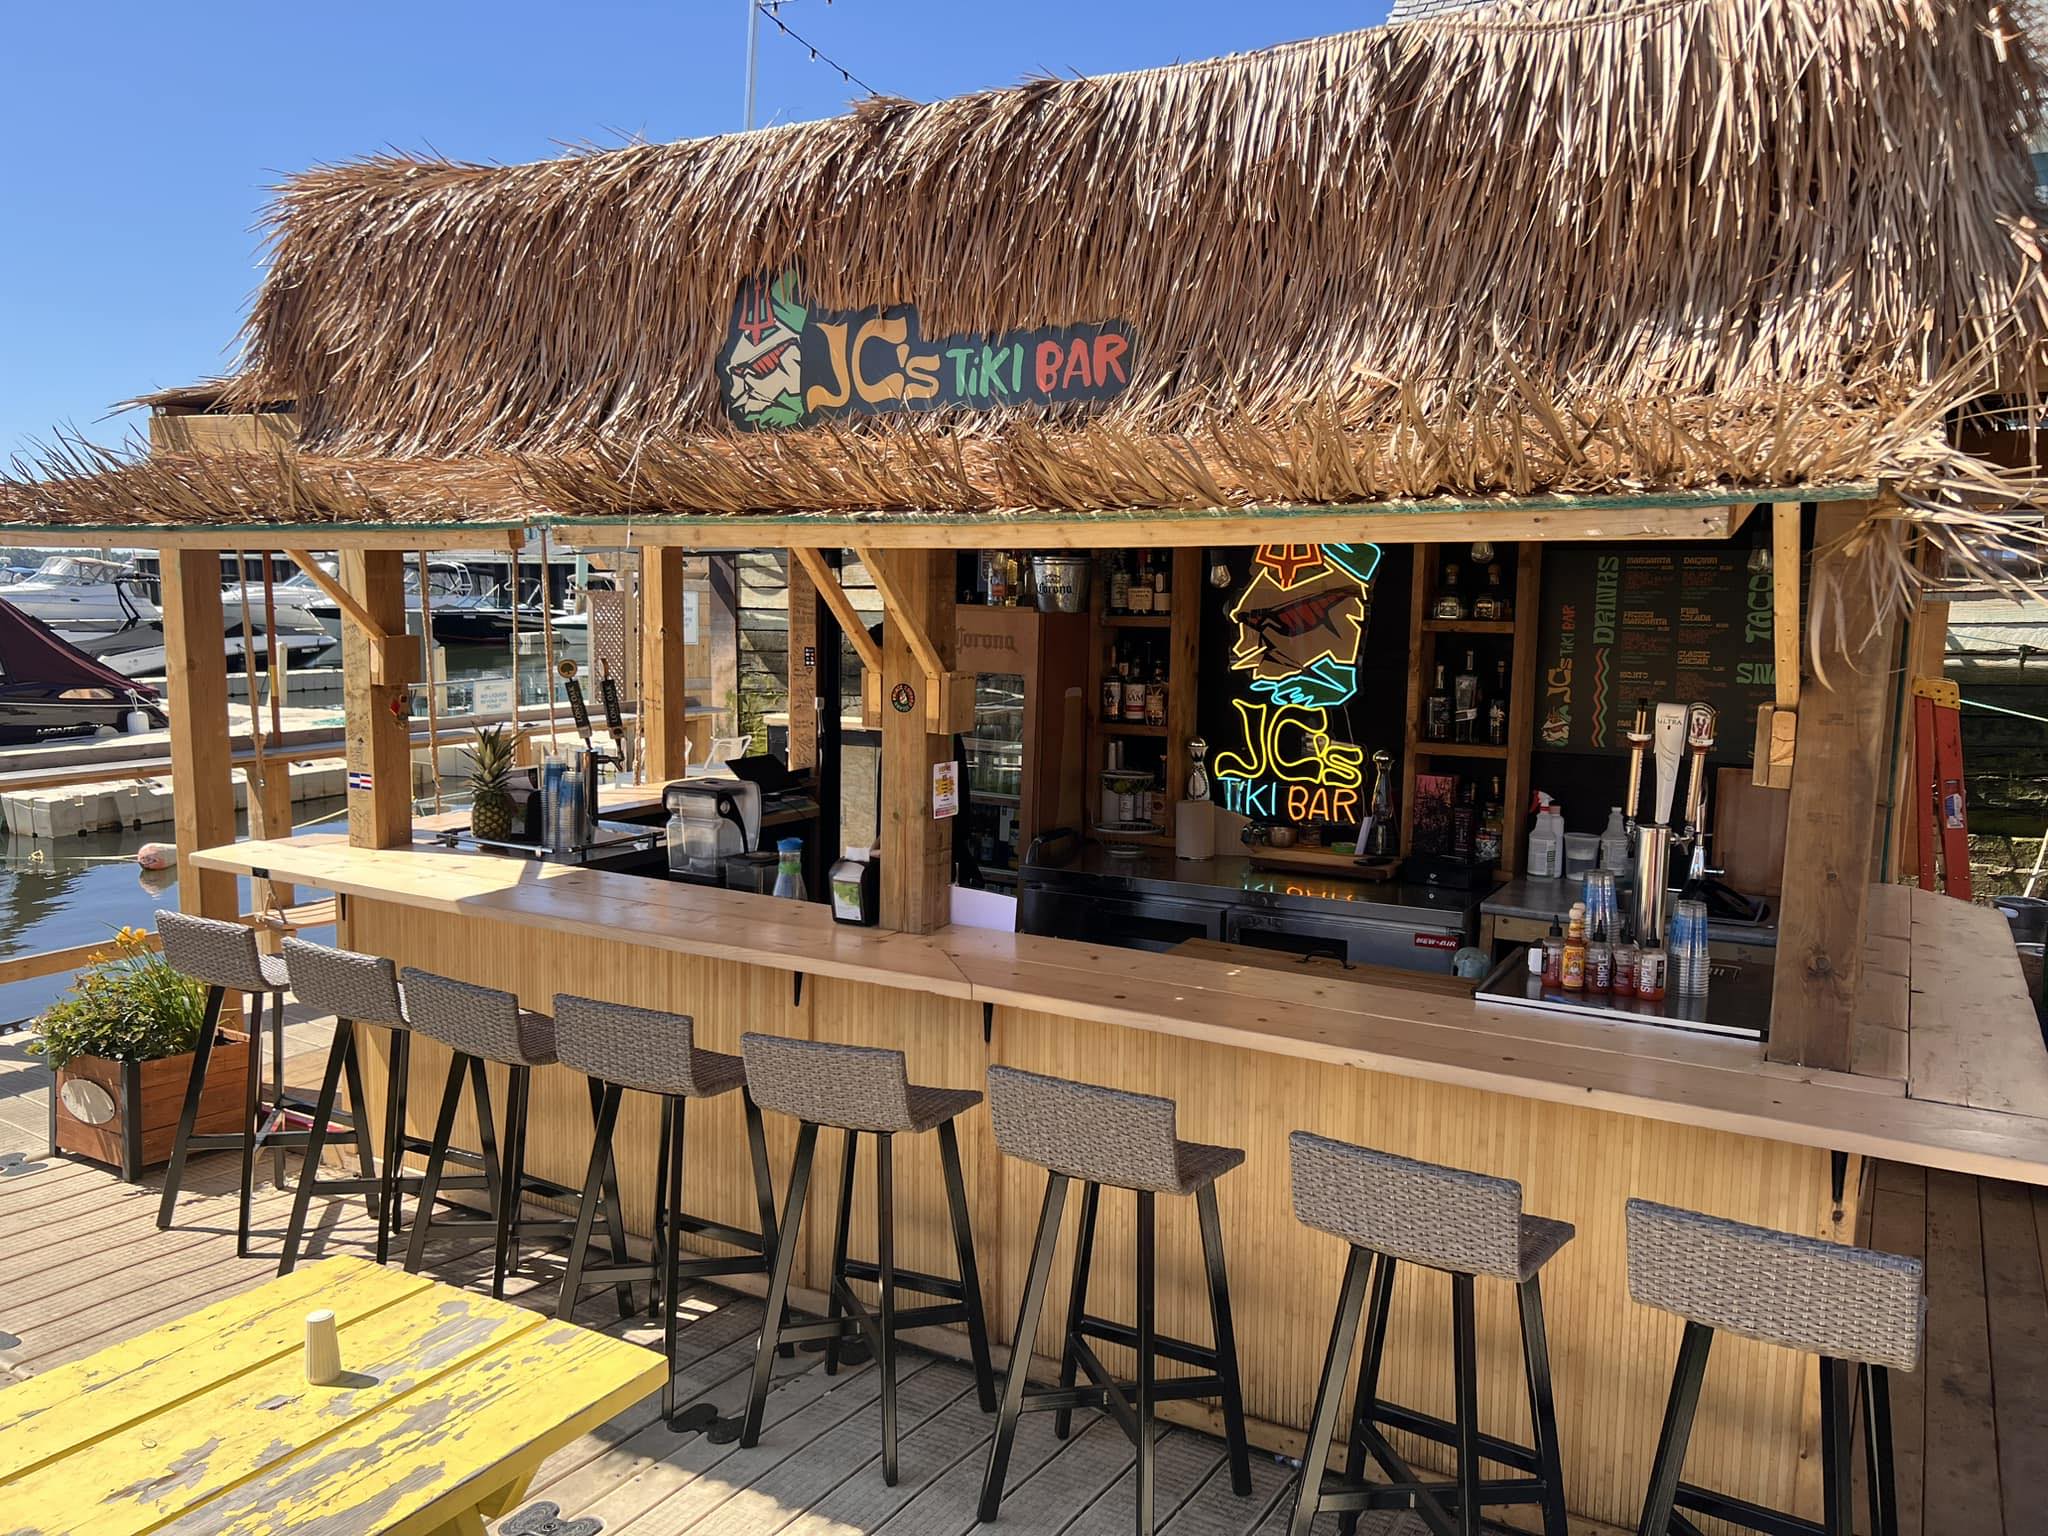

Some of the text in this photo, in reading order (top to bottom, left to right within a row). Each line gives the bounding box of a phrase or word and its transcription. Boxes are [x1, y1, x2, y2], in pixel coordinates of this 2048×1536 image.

[805, 317, 940, 414] JC's
[1035, 333, 1128, 393] BAR
[1036, 579, 1074, 595] Corona
[1592, 555, 1620, 645] DRINKS
[1561, 604, 1577, 631] BAR
[1656, 718, 1683, 727] ULTRA
[1214, 697, 1364, 790] JC's
[1287, 784, 1359, 825] BAR
[1596, 953, 1609, 989] SIMPLE
[1640, 958, 1653, 994] SIMPLE
